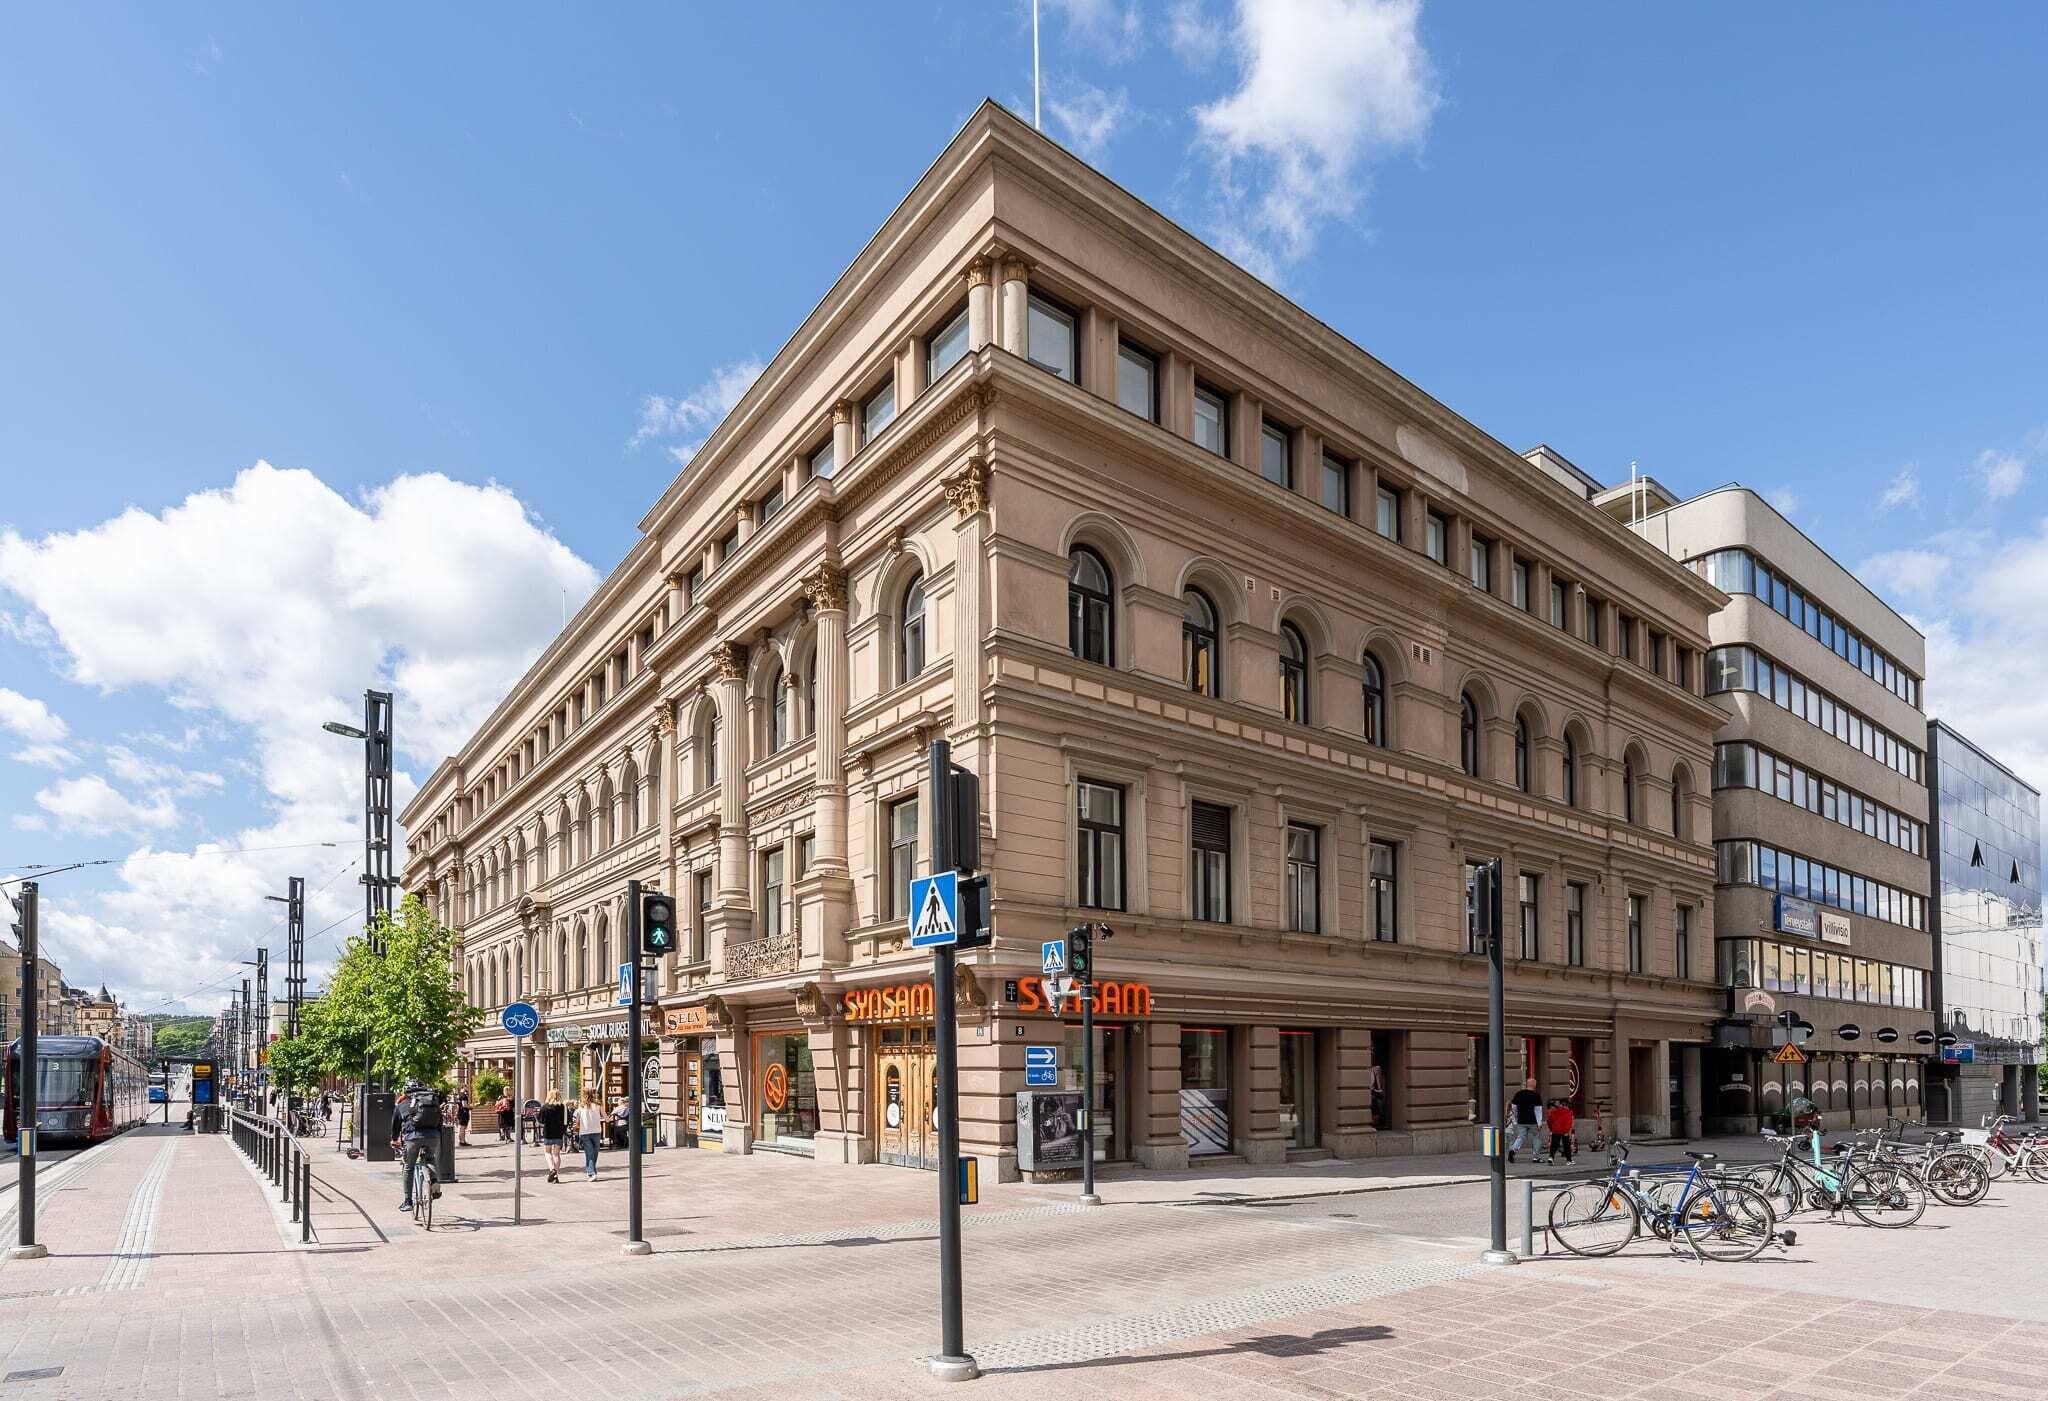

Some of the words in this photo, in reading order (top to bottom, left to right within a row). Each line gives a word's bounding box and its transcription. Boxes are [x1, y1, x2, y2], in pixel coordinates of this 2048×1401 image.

[845, 983, 934, 1020] SYNSAM
[1018, 976, 1150, 1016] SNAM
[588, 1023, 609, 1041] SOCIAL
[52, 1062, 60, 1070] 3
